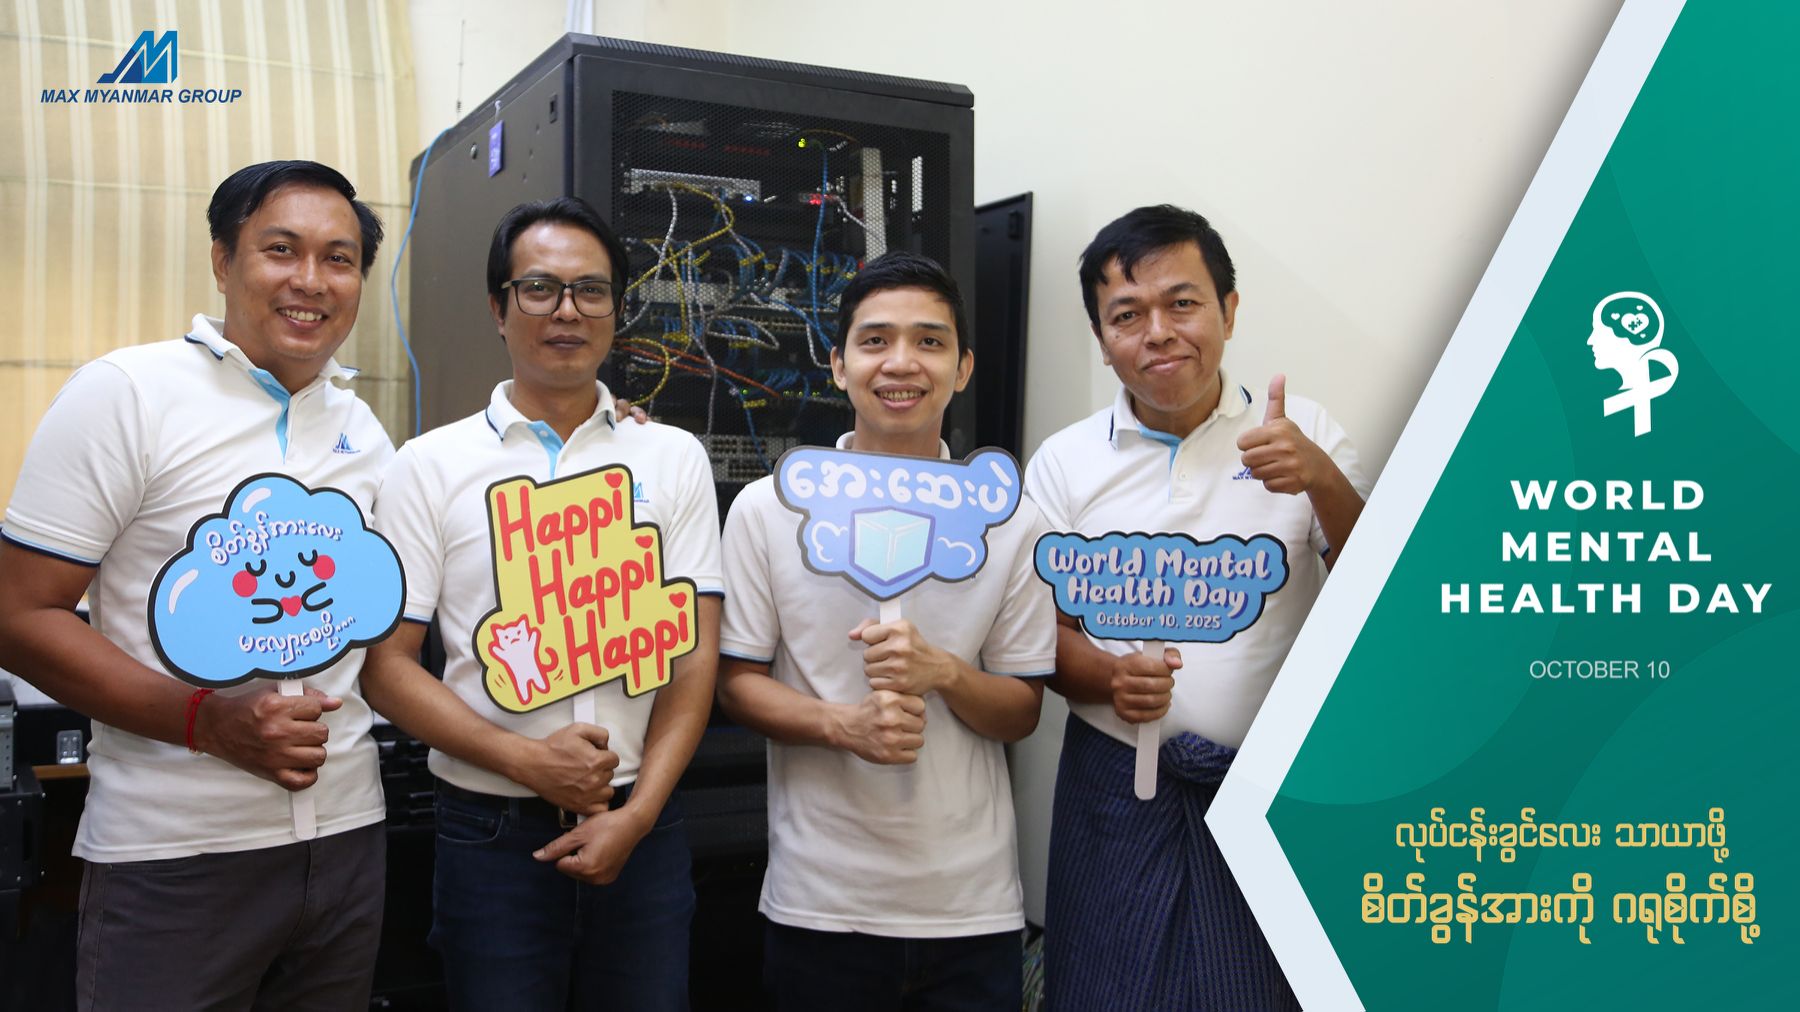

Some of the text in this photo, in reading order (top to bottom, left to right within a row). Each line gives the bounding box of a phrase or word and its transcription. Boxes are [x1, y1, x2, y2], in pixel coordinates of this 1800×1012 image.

[786, 460, 1013, 513] အေးဆေးပဲ
[496, 473, 623, 566] Happi
[528, 535, 654, 629] Happi
[1048, 546, 1271, 579] World Mental
[1067, 575, 1247, 618] Health Day
[1096, 612, 1222, 629] October 10, 2025
[563, 592, 689, 689] Happi
